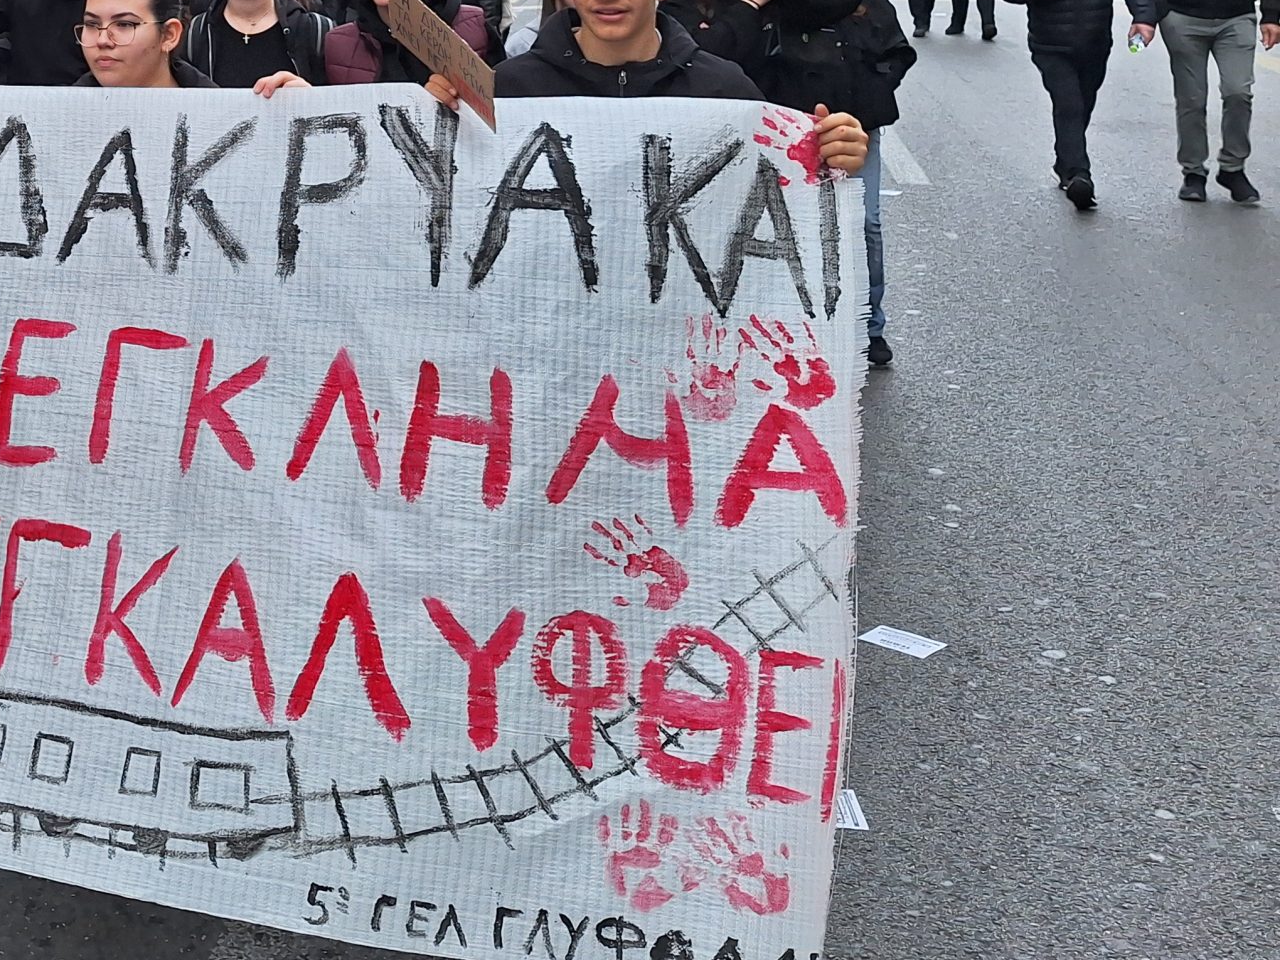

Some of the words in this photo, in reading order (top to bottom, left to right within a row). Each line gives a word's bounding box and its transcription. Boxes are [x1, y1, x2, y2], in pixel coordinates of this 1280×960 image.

[639, 124, 841, 321] ΚΑΙ
[370, 894, 468, 949] ΓΕΛ
[494, 906, 820, 960] ΓΛΥΦ
